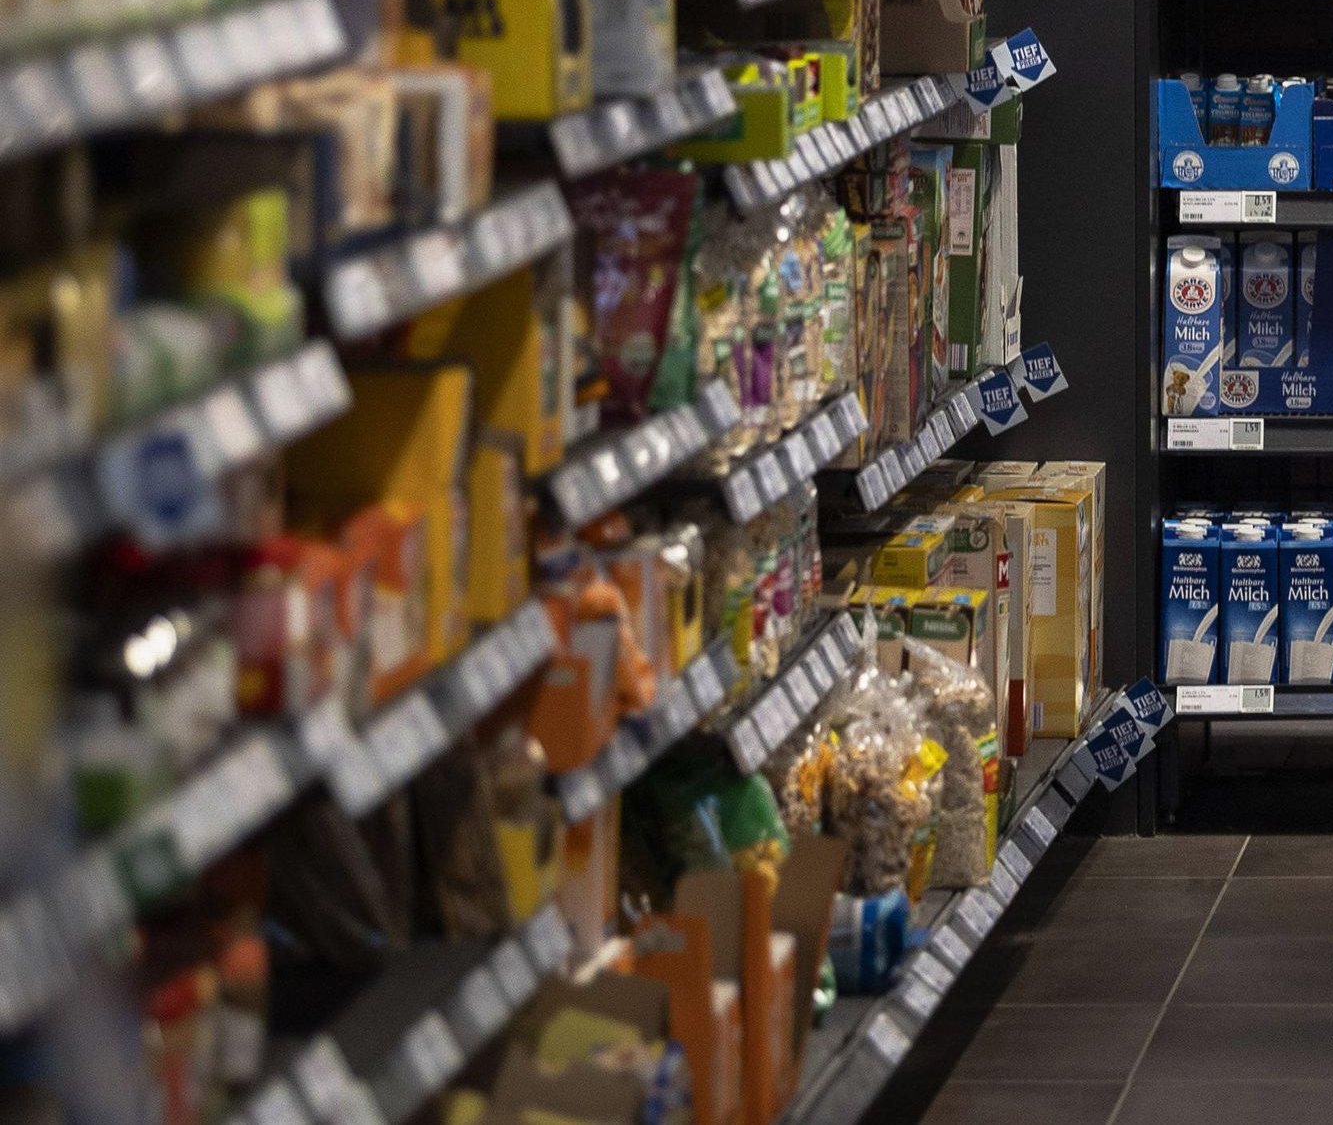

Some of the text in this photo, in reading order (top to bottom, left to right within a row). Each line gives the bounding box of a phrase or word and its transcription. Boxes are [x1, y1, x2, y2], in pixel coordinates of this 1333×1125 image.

[1012, 43, 1038, 61] TIEF
[1174, 326, 1210, 341] Milch
[1026, 357, 1052, 371] TIEF
[1282, 382, 1316, 398] Milch
[1168, 584, 1210, 600] Milch
[1228, 587, 1269, 602] Milch
[1288, 585, 1329, 601] Milch
[1133, 690, 1158, 709] TIEF
